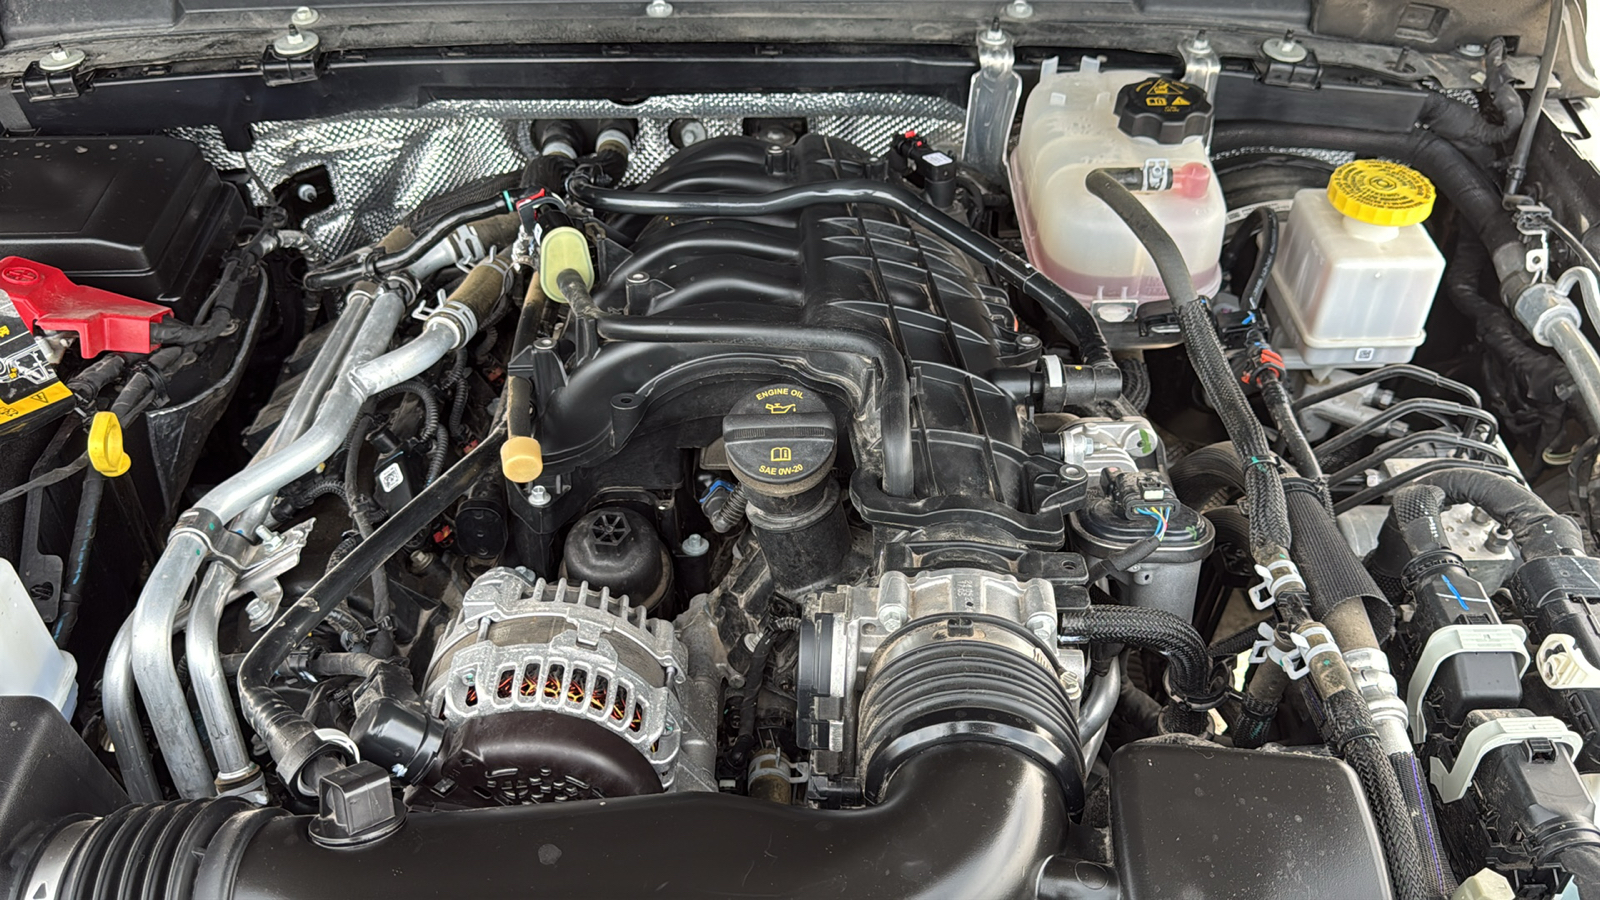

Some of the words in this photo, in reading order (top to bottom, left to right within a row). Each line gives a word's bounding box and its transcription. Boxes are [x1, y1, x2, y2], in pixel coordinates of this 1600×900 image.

[756, 388, 789, 400] ENGINE
[790, 389, 804, 399] OIL
[759, 465, 777, 475] SAE
[778, 464, 803, 475] 0W-20
